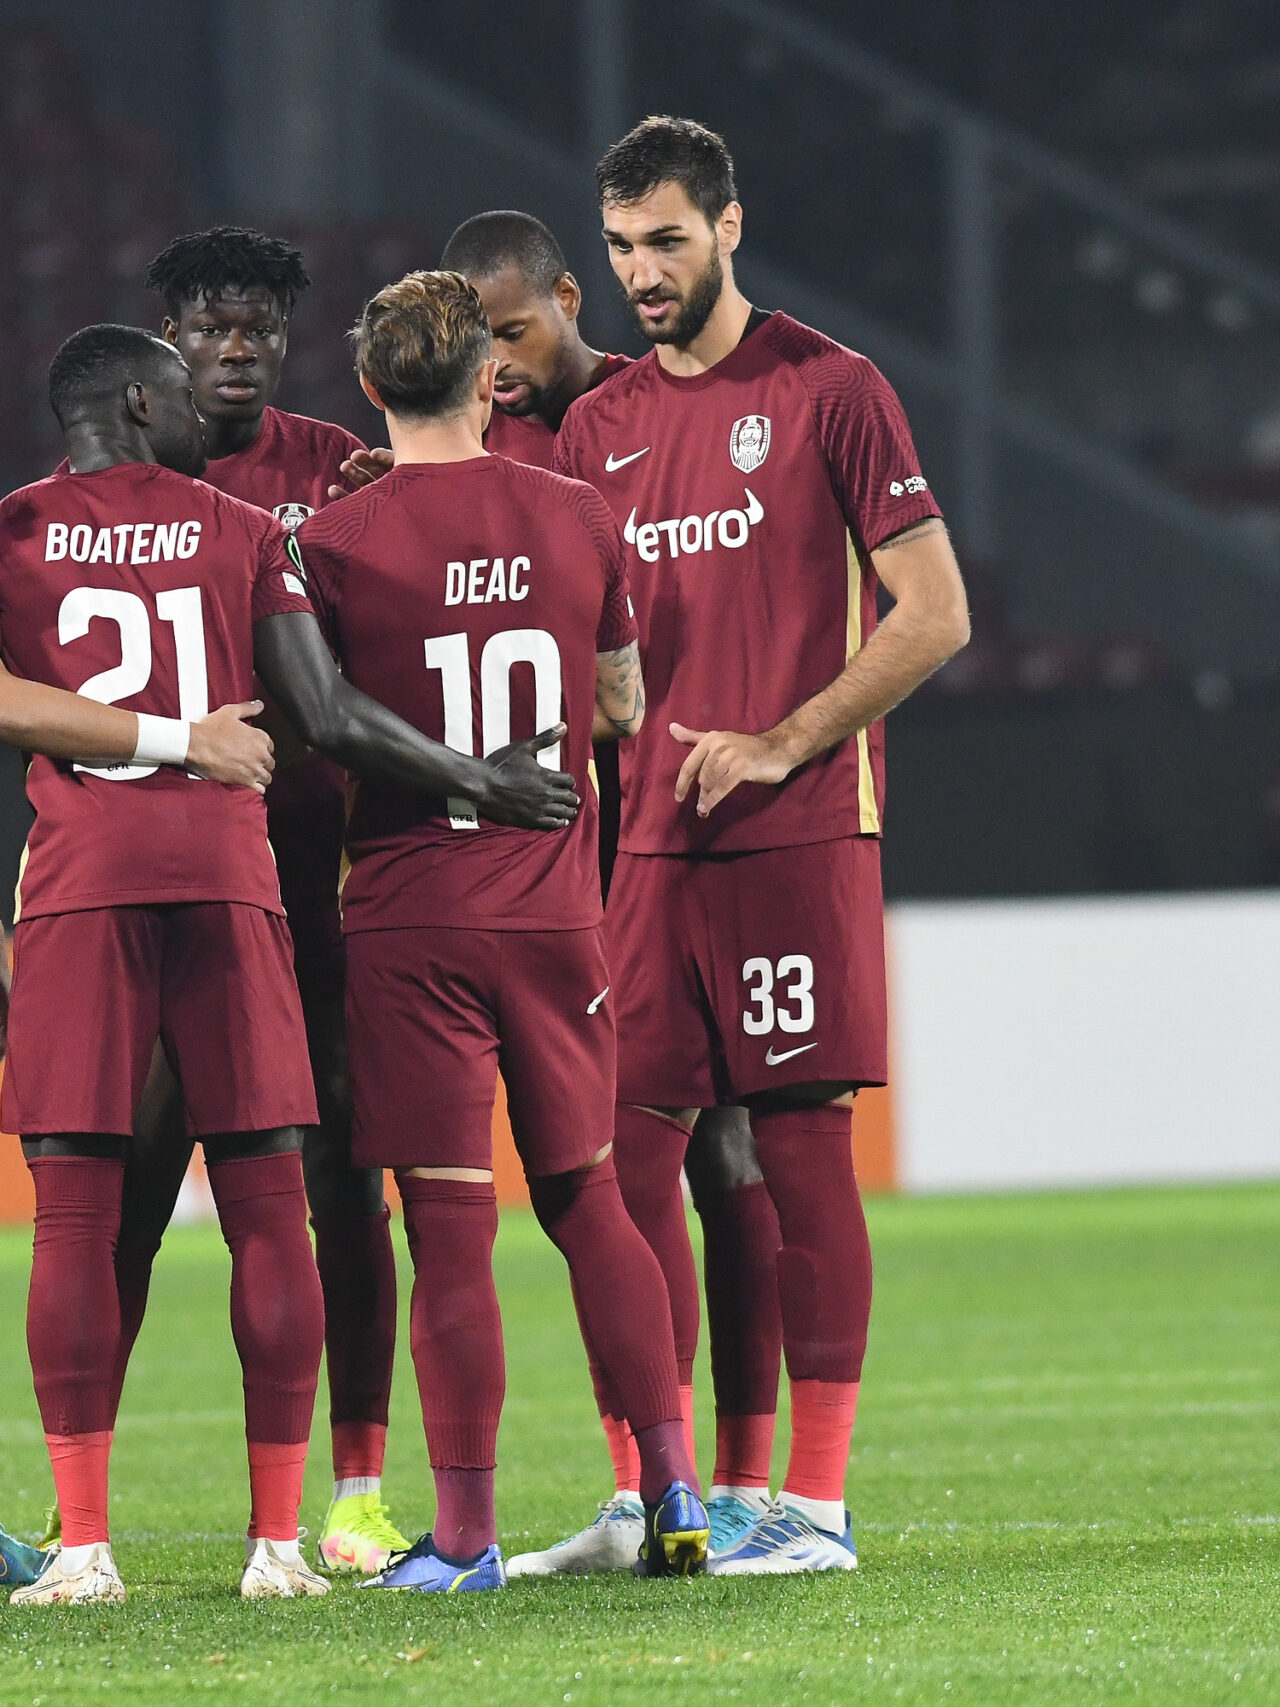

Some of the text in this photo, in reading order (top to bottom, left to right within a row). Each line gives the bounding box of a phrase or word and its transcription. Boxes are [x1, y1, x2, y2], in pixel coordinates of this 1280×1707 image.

[44, 520, 202, 565] BOATENG
[444, 555, 531, 606] DEAC
[57, 586, 209, 781] 21
[424, 629, 562, 829] 10
[742, 954, 815, 1036] 33
